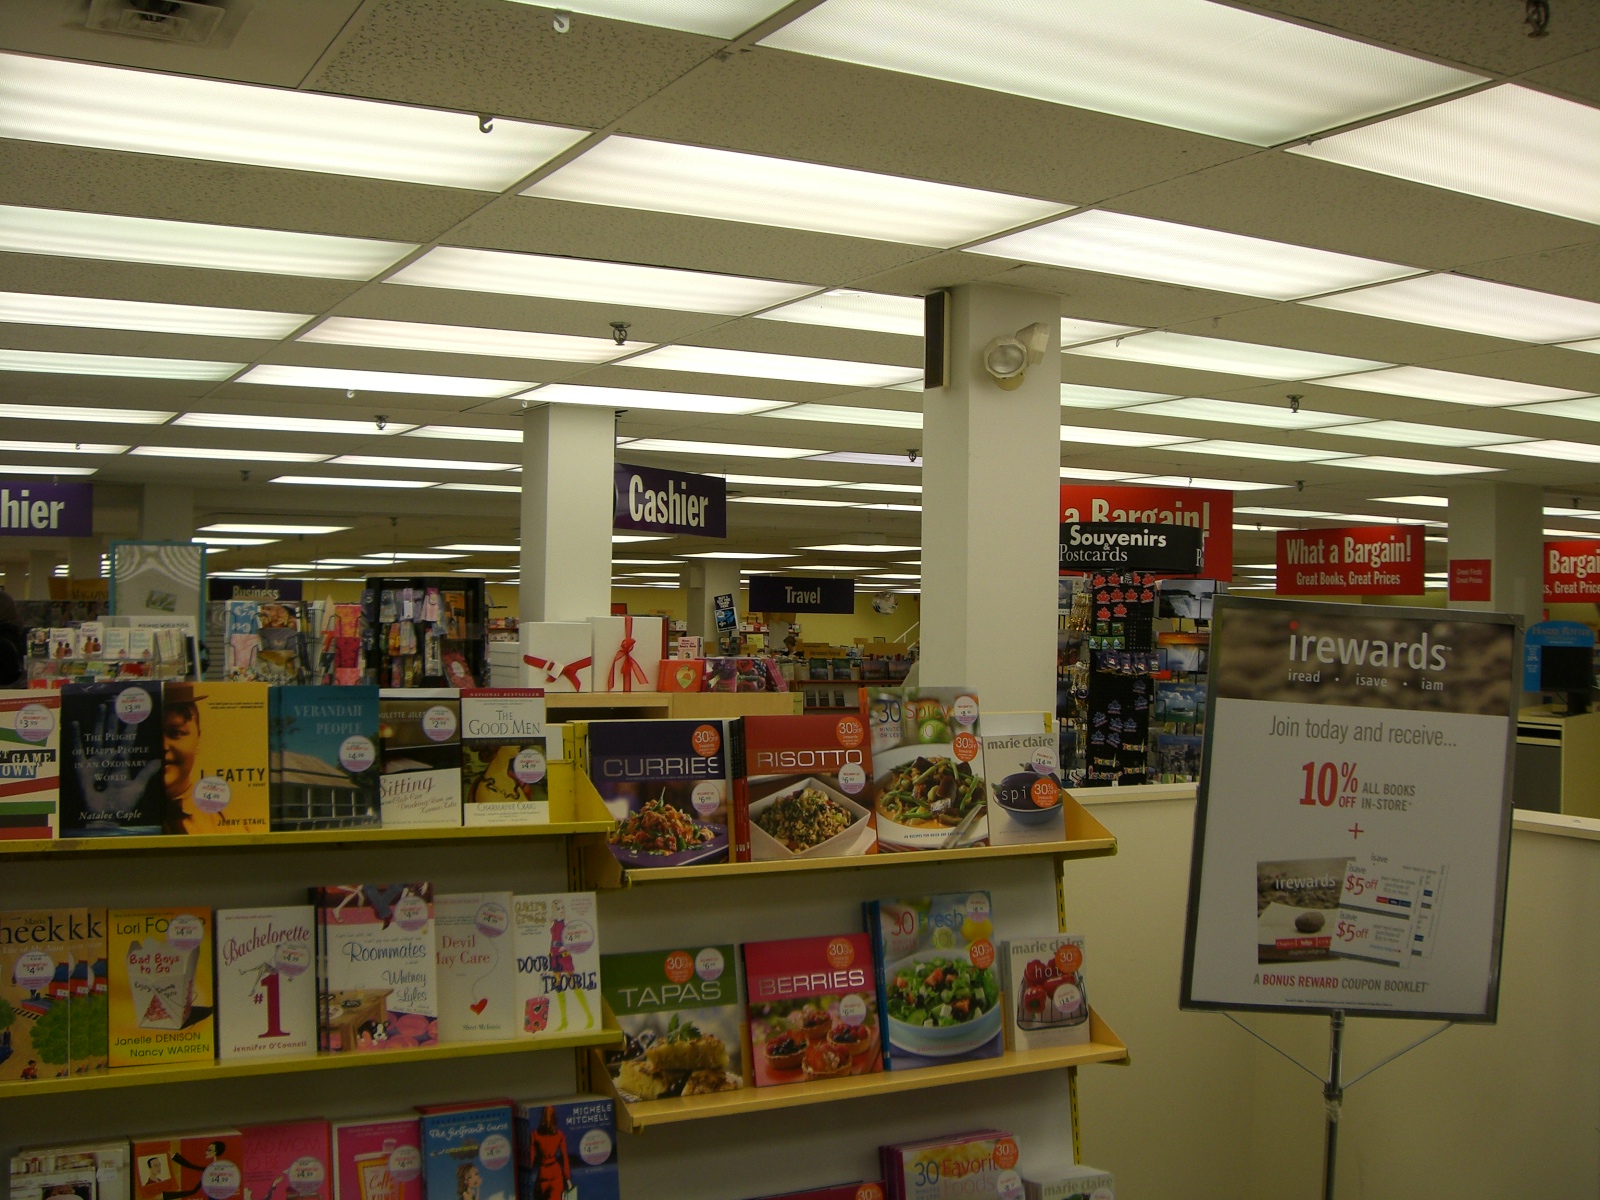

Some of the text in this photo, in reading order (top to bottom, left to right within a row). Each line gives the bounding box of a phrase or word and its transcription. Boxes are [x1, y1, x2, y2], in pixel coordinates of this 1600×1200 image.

[1, 488, 65, 529] hier
[628, 474, 709, 528] Cashier
[1091, 498, 1210, 538] Bargain!
[1069, 525, 1167, 548] Souvenirs
[1059, 543, 1128, 562] Postcards
[1102, 542, 1110, 551] &
[1286, 534, 1412, 568] What a Bargain!
[1296, 570, 1401, 587] Great Books, Great Prices
[1554, 581, 1578, 594] Great
[232, 585, 280, 600] Business
[784, 586, 821, 604] Travel
[1288, 668, 1444, 691] iread isave iam
[294, 704, 362, 718] VERANDAH
[878, 699, 903, 723] 30
[316, 722, 362, 735] PEOPLE
[1269, 715, 1300, 738] Join
[1305, 718, 1349, 745] today
[1353, 722, 1384, 743] and
[987, 736, 1055, 750] marie claire
[12, 752, 51, 764] GAME
[603, 756, 719, 777] CURRIES
[757, 749, 863, 768] RISOTTO
[216, 768, 265, 782] FATTY
[1299, 761, 1359, 807] 10%
[380, 776, 435, 799] Sitting
[1361, 782, 1416, 797] ALL BOOKS
[1338, 796, 1357, 808] OFF
[78, 809, 142, 822] Natalee Caple
[217, 818, 266, 827] JERRY STAHL
[1275, 873, 1337, 890] irewards
[1345, 873, 1365, 896] $5
[1365, 878, 1379, 891] off
[890, 911, 915, 936] 30
[917, 909, 964, 929] Fresh
[116, 922, 141, 935] Lori
[1336, 920, 1356, 942] $5
[1355, 927, 1370, 940] off
[222, 922, 310, 967] Bachelorette
[442, 934, 476, 948] Devil
[1011, 941, 1047, 955] marie
[129, 953, 180, 965] Bad Boys
[341, 941, 427, 962] Roommates
[460, 951, 490, 965] Care
[1060, 952, 1073, 963] 30
[139, 963, 171, 974] to Go
[517, 953, 564, 973] DOUBLE
[381, 969, 426, 987] Whitney
[541, 972, 598, 994] TROUBLE
[758, 969, 865, 996] BERRIES
[1253, 973, 1427, 993] A BONUS REWARD COUPON BOOKLET
[397, 986, 427, 1007] Lyles
[618, 980, 722, 1008] TAPAS
[114, 1032, 201, 1046] Janelle DENISON
[233, 1041, 307, 1053] Jennifer O'Connell
[130, 1044, 210, 1059] Nancy WARREN
[572, 1103, 612, 1116] MICHELE
[565, 1113, 609, 1126] MITCHELL
[914, 1160, 939, 1187] 30
[943, 1175, 995, 1196] Foods
[1043, 1176, 1112, 1197] marie claire
